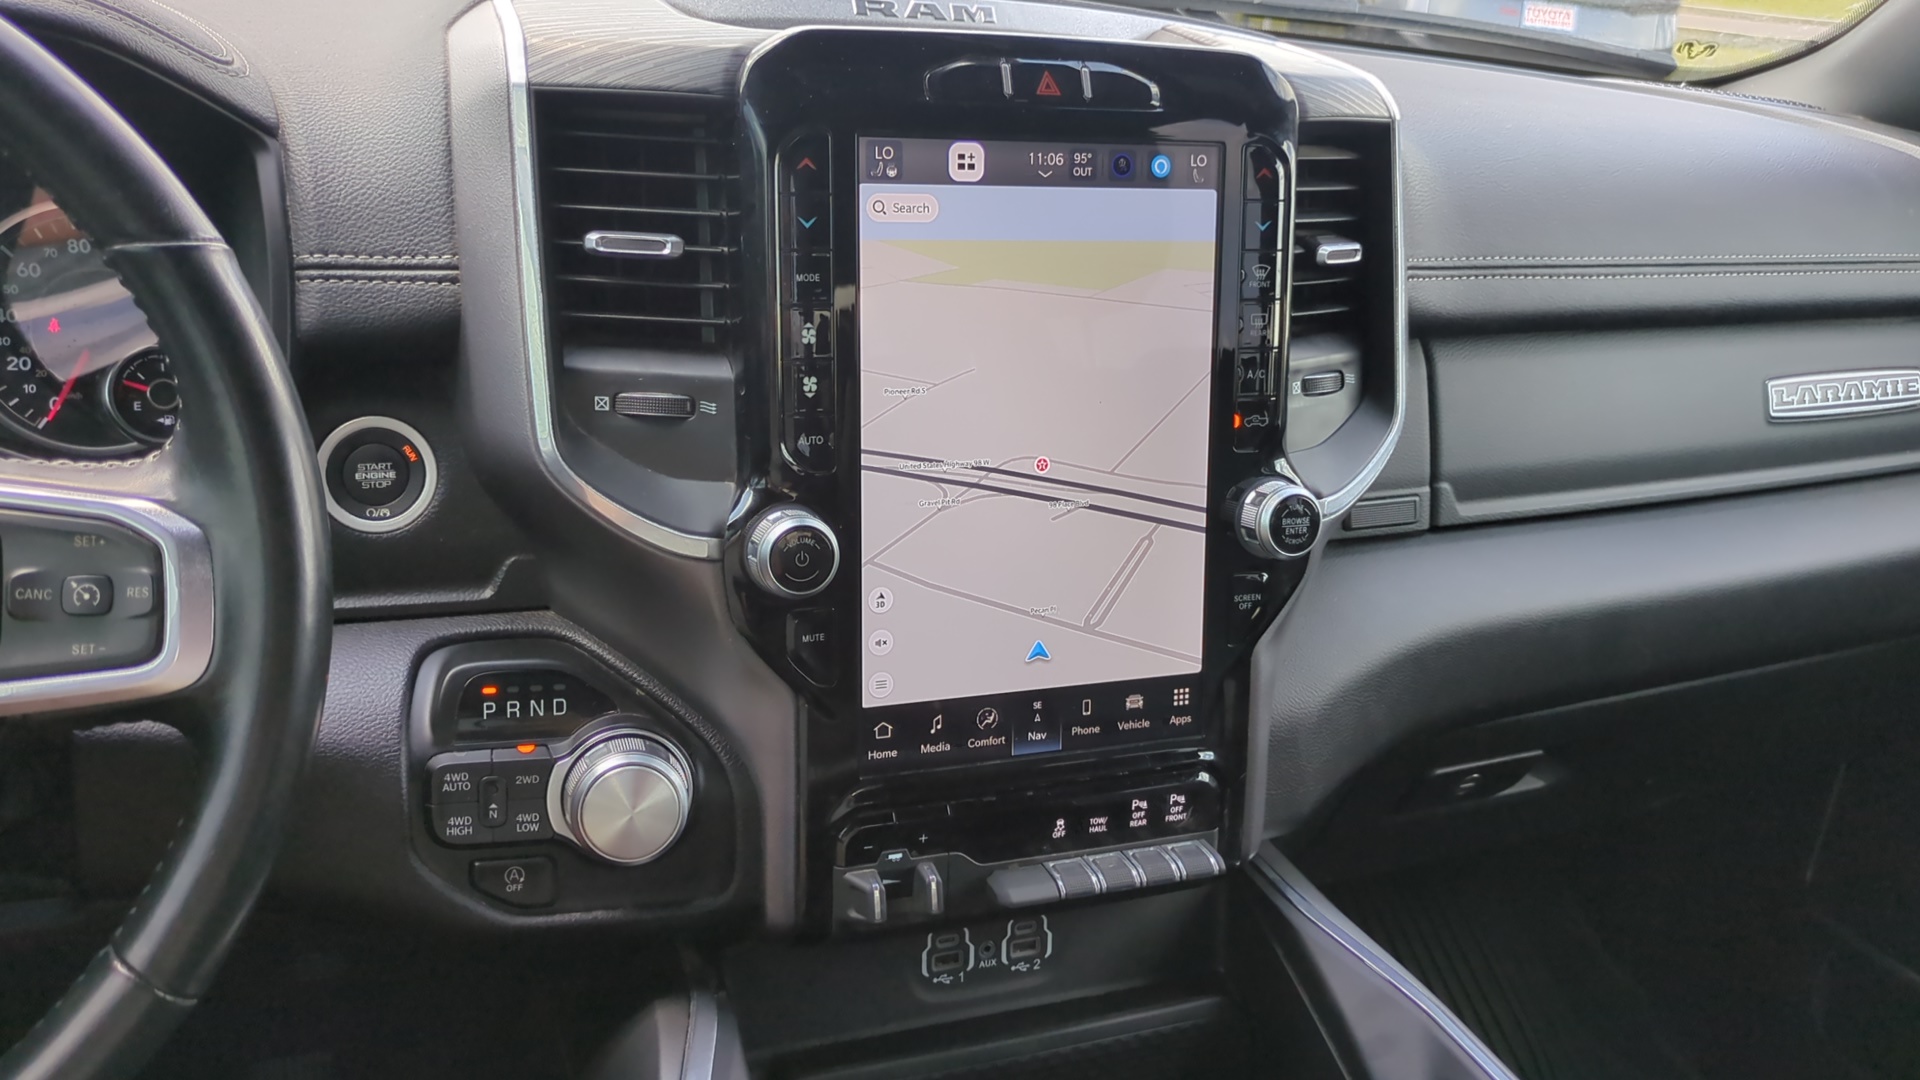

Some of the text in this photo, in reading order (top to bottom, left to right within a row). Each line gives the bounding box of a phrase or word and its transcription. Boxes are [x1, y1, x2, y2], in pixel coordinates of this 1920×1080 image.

[852, 0, 997, 24] RAM
[875, 147, 894, 159] LO
[1029, 153, 1064, 166] 11:06
[1074, 153, 1092, 164] 95°
[1190, 155, 1207, 167] LO
[1073, 166, 1093, 177] OUT
[893, 202, 930, 214] Search
[67, 239, 91, 254] 80
[43, 247, 58, 258] 70
[17, 262, 41, 278] 60
[796, 273, 820, 282] MODE
[3, 285, 19, 294] 50
[6, 356, 31, 371] 20
[1247, 369, 1266, 379] A/C
[22, 384, 37, 394] 10
[1772, 376, 1920, 410] LARAMIE
[133, 401, 142, 411] E
[798, 436, 824, 445] AUTO
[402, 444, 418, 462] RUN
[357, 462, 393, 471] START
[944, 461, 972, 469] Highway
[355, 471, 397, 480] ENGINE
[361, 481, 391, 489] STOP
[1289, 504, 1305, 512] TUNE
[1282, 517, 1310, 526] BROWSE
[1285, 526, 1308, 535] ENTER
[787, 537, 816, 549] VOLUME
[1284, 536, 1306, 545] SCROLL
[15, 589, 52, 600] CANC
[127, 587, 149, 598] RES
[1234, 594, 1261, 602] SCREEN
[875, 600, 886, 609] 3D
[1239, 602, 1252, 610] OFF
[802, 633, 825, 643] MUTE
[483, 698, 567, 719] P R N D
[1033, 701, 1042, 709] SE
[1117, 718, 1150, 731] Vehicle
[1169, 714, 1191, 726] Apps
[1071, 724, 1100, 736] Phone
[1028, 731, 1047, 741] Nav
[968, 735, 1006, 748] Comfort
[920, 742, 950, 754] Media
[868, 749, 898, 760] Home
[444, 772, 469, 782] 4WD
[515, 775, 540, 785] 2WD
[442, 781, 471, 792] AUTO
[489, 809, 498, 819] N
[1132, 811, 1145, 819] OFF
[1170, 806, 1183, 814] OFF
[447, 816, 472, 826] 4WD
[516, 813, 540, 823] 4WD
[1089, 816, 1108, 826] TOW/
[1165, 813, 1187, 822] FRONT
[516, 822, 540, 833] LOW
[1129, 819, 1147, 828] REAR
[446, 826, 473, 837] HIGH
[1089, 825, 1108, 833] HAUL
[1052, 831, 1066, 839] OFF
[506, 884, 523, 892] OFF
[978, 958, 997, 968] AUX
[1033, 959, 1041, 970] 2
[958, 972, 964, 983] 1
